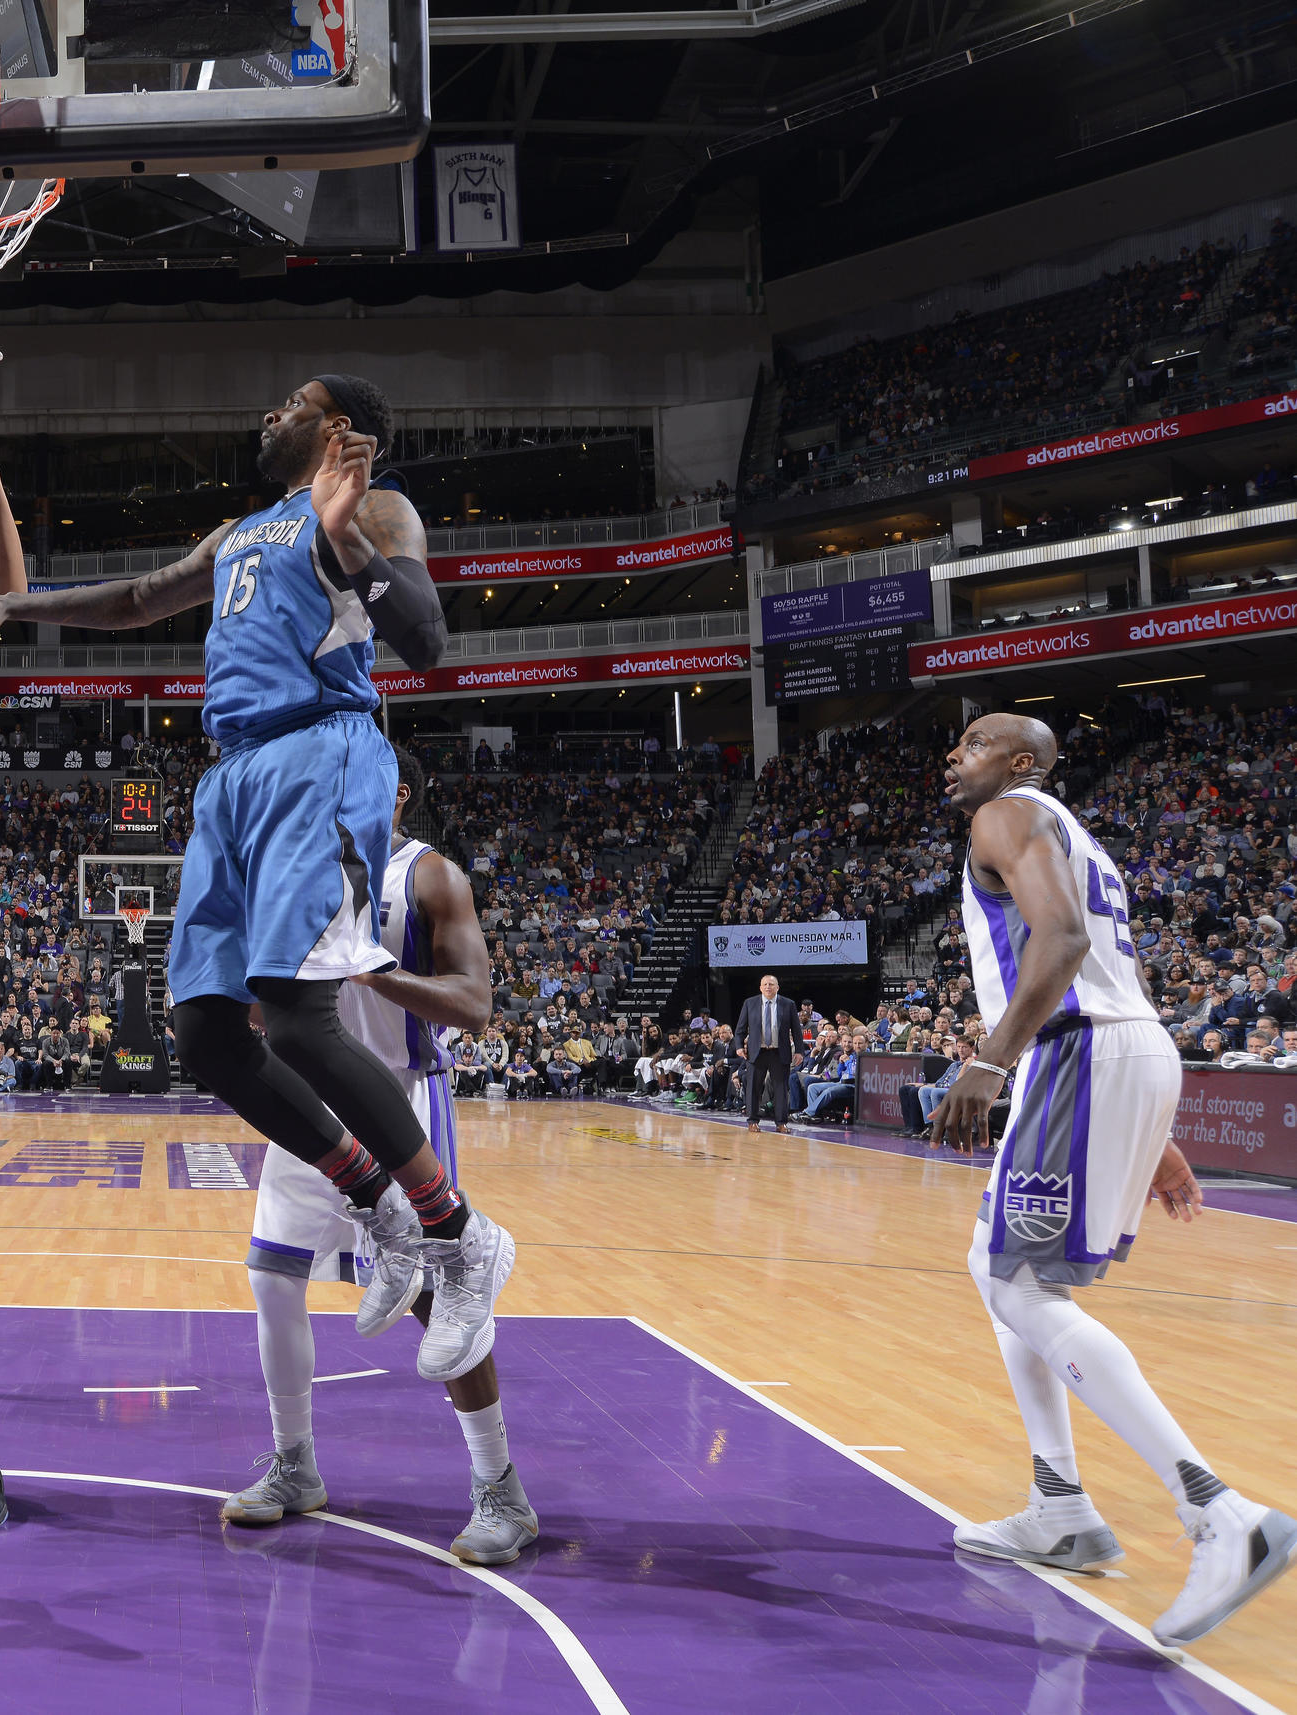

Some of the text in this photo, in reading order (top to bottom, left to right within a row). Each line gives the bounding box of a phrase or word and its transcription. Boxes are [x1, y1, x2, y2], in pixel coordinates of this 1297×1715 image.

[6, 53, 29, 79] BONUS
[241, 58, 259, 80] TEAM
[267, 53, 295, 83] FOULS
[298, 54, 328, 71] NBA
[445, 152, 505, 168] SIXTH MAN
[484, 208, 493, 220] 6
[1026, 422, 1179, 465] advantelnetworks
[928, 466, 969, 484] 9:21 PM
[218, 515, 309, 562] MINNESOTA
[617, 534, 733, 567] advantelnetworks
[460, 555, 582, 575] advantelnetworks
[220, 552, 262, 620] 15
[883, 581, 901, 589] TOTAL
[773, 593, 829, 608] 50/50 RAFFLE
[869, 592, 905, 607] $6,455
[813, 625, 834, 633] ALLIANCE
[790, 627, 902, 651] DRAFTKINGS FANTASY LEADERS
[834, 642, 855, 650] OVERALL
[926, 631, 1090, 669] advantelnetworks
[612, 652, 740, 675] advantelnetworks
[457, 664, 578, 686] advantelnetworks
[784, 670, 805, 678] JAMES
[807, 667, 832, 675] HARDEN
[18, 681, 132, 695] advantelnetworks
[785, 680, 806, 688] DEMAR
[808, 675, 837, 685] DEROZAN
[785, 688, 819, 698] DRAYMOND
[820, 685, 840, 693] GREEN
[20, 696, 53, 709] CSN
[64, 761, 82, 769] CSN
[123, 784, 155, 797] 10:21
[121, 797, 152, 820] 24
[126, 824, 159, 832] TISSOT
[770, 933, 828, 943] WEDNESDAY
[831, 932, 855, 941] MAR.
[799, 945, 833, 954] 7:30PM
[117, 1055, 153, 1064] DRAFT
[121, 1062, 153, 1070] KINGS
[880, 1099, 903, 1118] netw
[1206, 1096, 1264, 1123] storage
[1172, 1115, 1265, 1153] for the Kings
[1006, 1195, 1071, 1215] SAC
